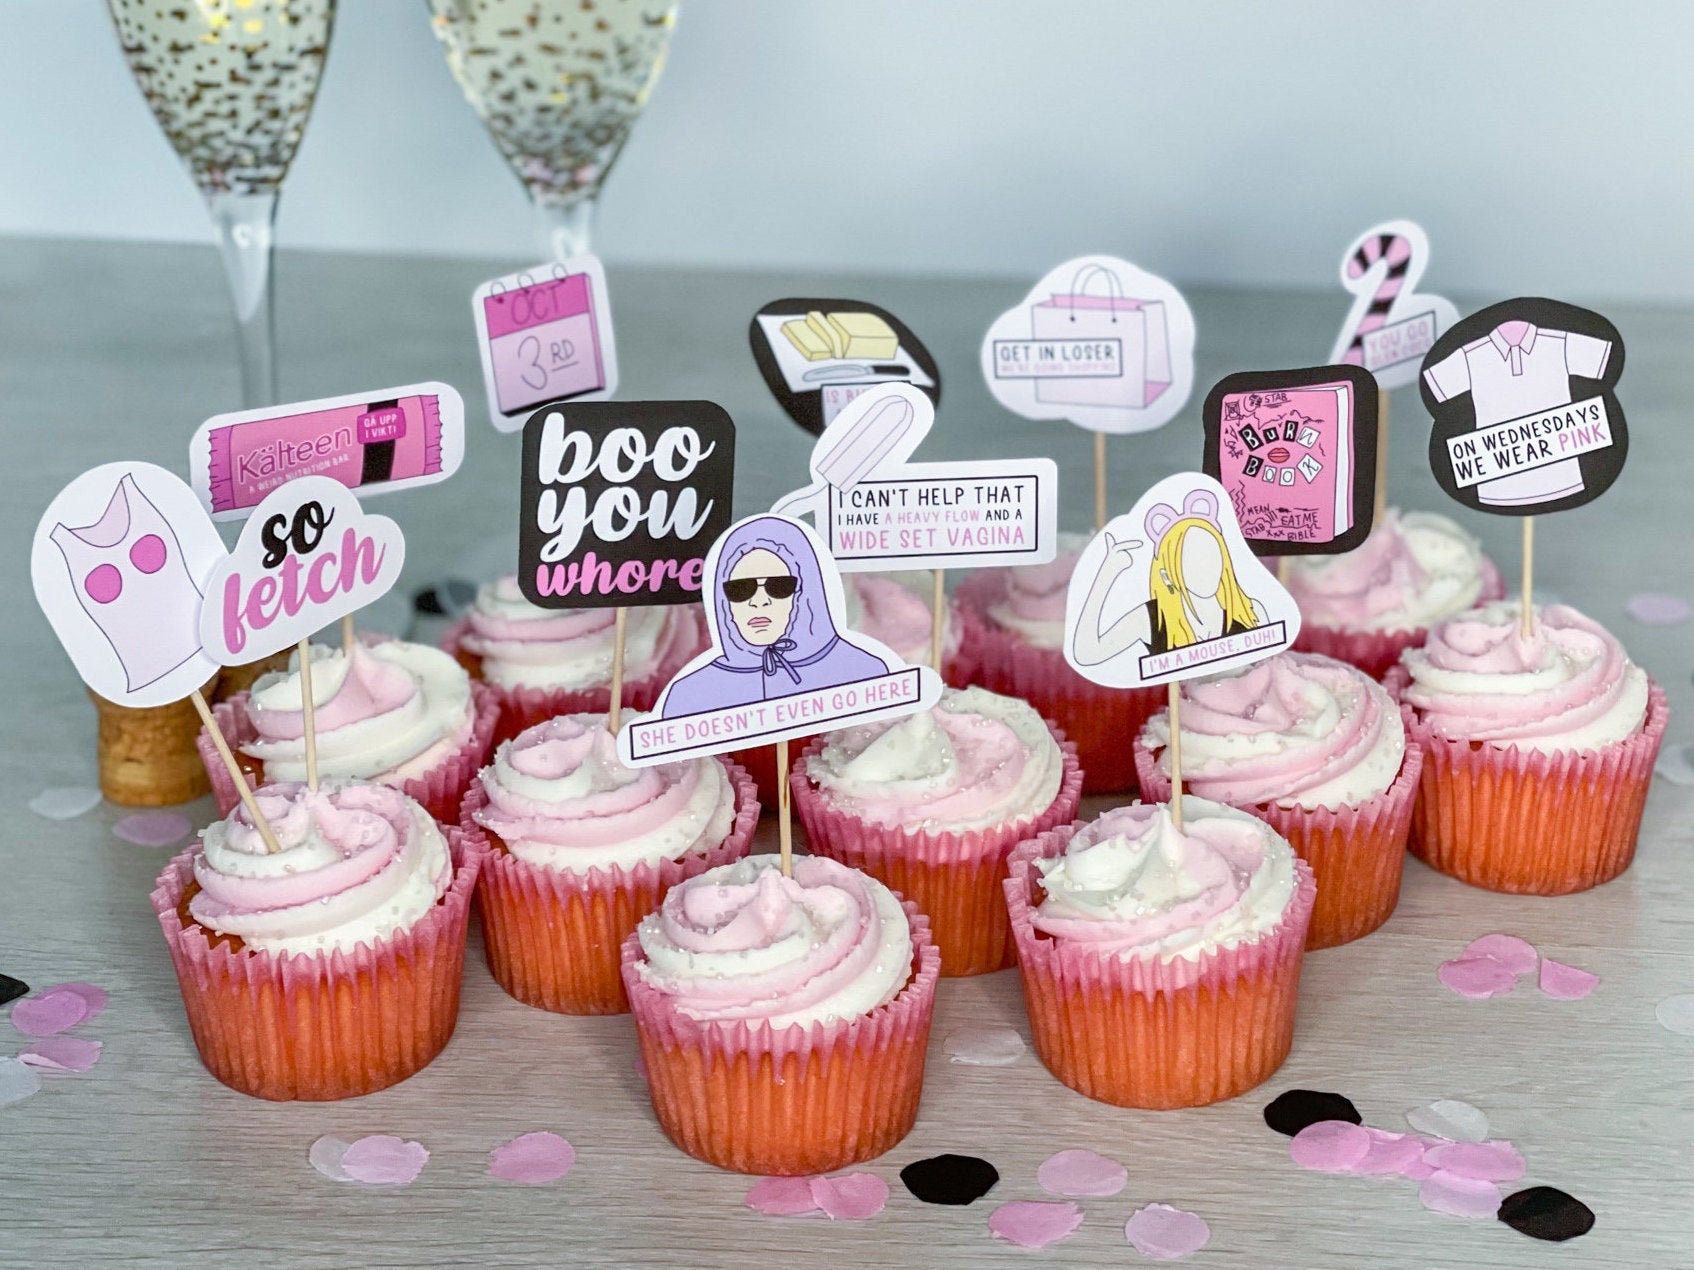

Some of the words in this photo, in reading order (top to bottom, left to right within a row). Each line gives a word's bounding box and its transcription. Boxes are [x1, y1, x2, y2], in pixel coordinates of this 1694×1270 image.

[511, 284, 561, 325] OCT
[1000, 345, 1031, 362] GET
[1039, 345, 1055, 361] IN
[1062, 344, 1114, 361] LOSER
[379, 413, 397, 425] UPP
[1264, 392, 1288, 404] STAB
[538, 412, 716, 485] boo
[1453, 440, 1477, 460] ON
[1482, 404, 1600, 451] WEDNESDAYS
[1455, 456, 1487, 481] WE
[1494, 440, 1553, 470] WEAR
[1558, 423, 1607, 453] PINK
[237, 426, 352, 484] Kälteen
[839, 490, 844, 508] I
[851, 488, 909, 508] CAN'T
[918, 487, 965, 506] HELP
[974, 485, 1025, 504] THAT
[846, 512, 879, 526] HAVE
[884, 513, 892, 525] A
[898, 510, 941, 525] HEAVY
[946, 509, 980, 523] FLOW
[985, 508, 1010, 521] AND
[1015, 508, 1023, 521] A
[1247, 503, 1270, 515] MEAN
[261, 500, 335, 569] so
[537, 486, 714, 562] you
[839, 529, 889, 550] WIDE
[900, 528, 937, 549] SET
[947, 526, 1025, 547] VAGINA
[1245, 523, 1266, 537] STAB
[1287, 529, 1316, 541] BIBLE
[223, 527, 386, 655] fetch
[536, 551, 704, 597] whore
[1150, 657, 1170, 673] I'M
[1175, 654, 1184, 664] A
[1243, 628, 1276, 648] DUH!
[640, 726, 677, 749] SHE
[684, 708, 767, 741] DOESN'T
[776, 697, 825, 723] EVEN
[832, 690, 858, 711] GO
[865, 678, 912, 709] HERE
